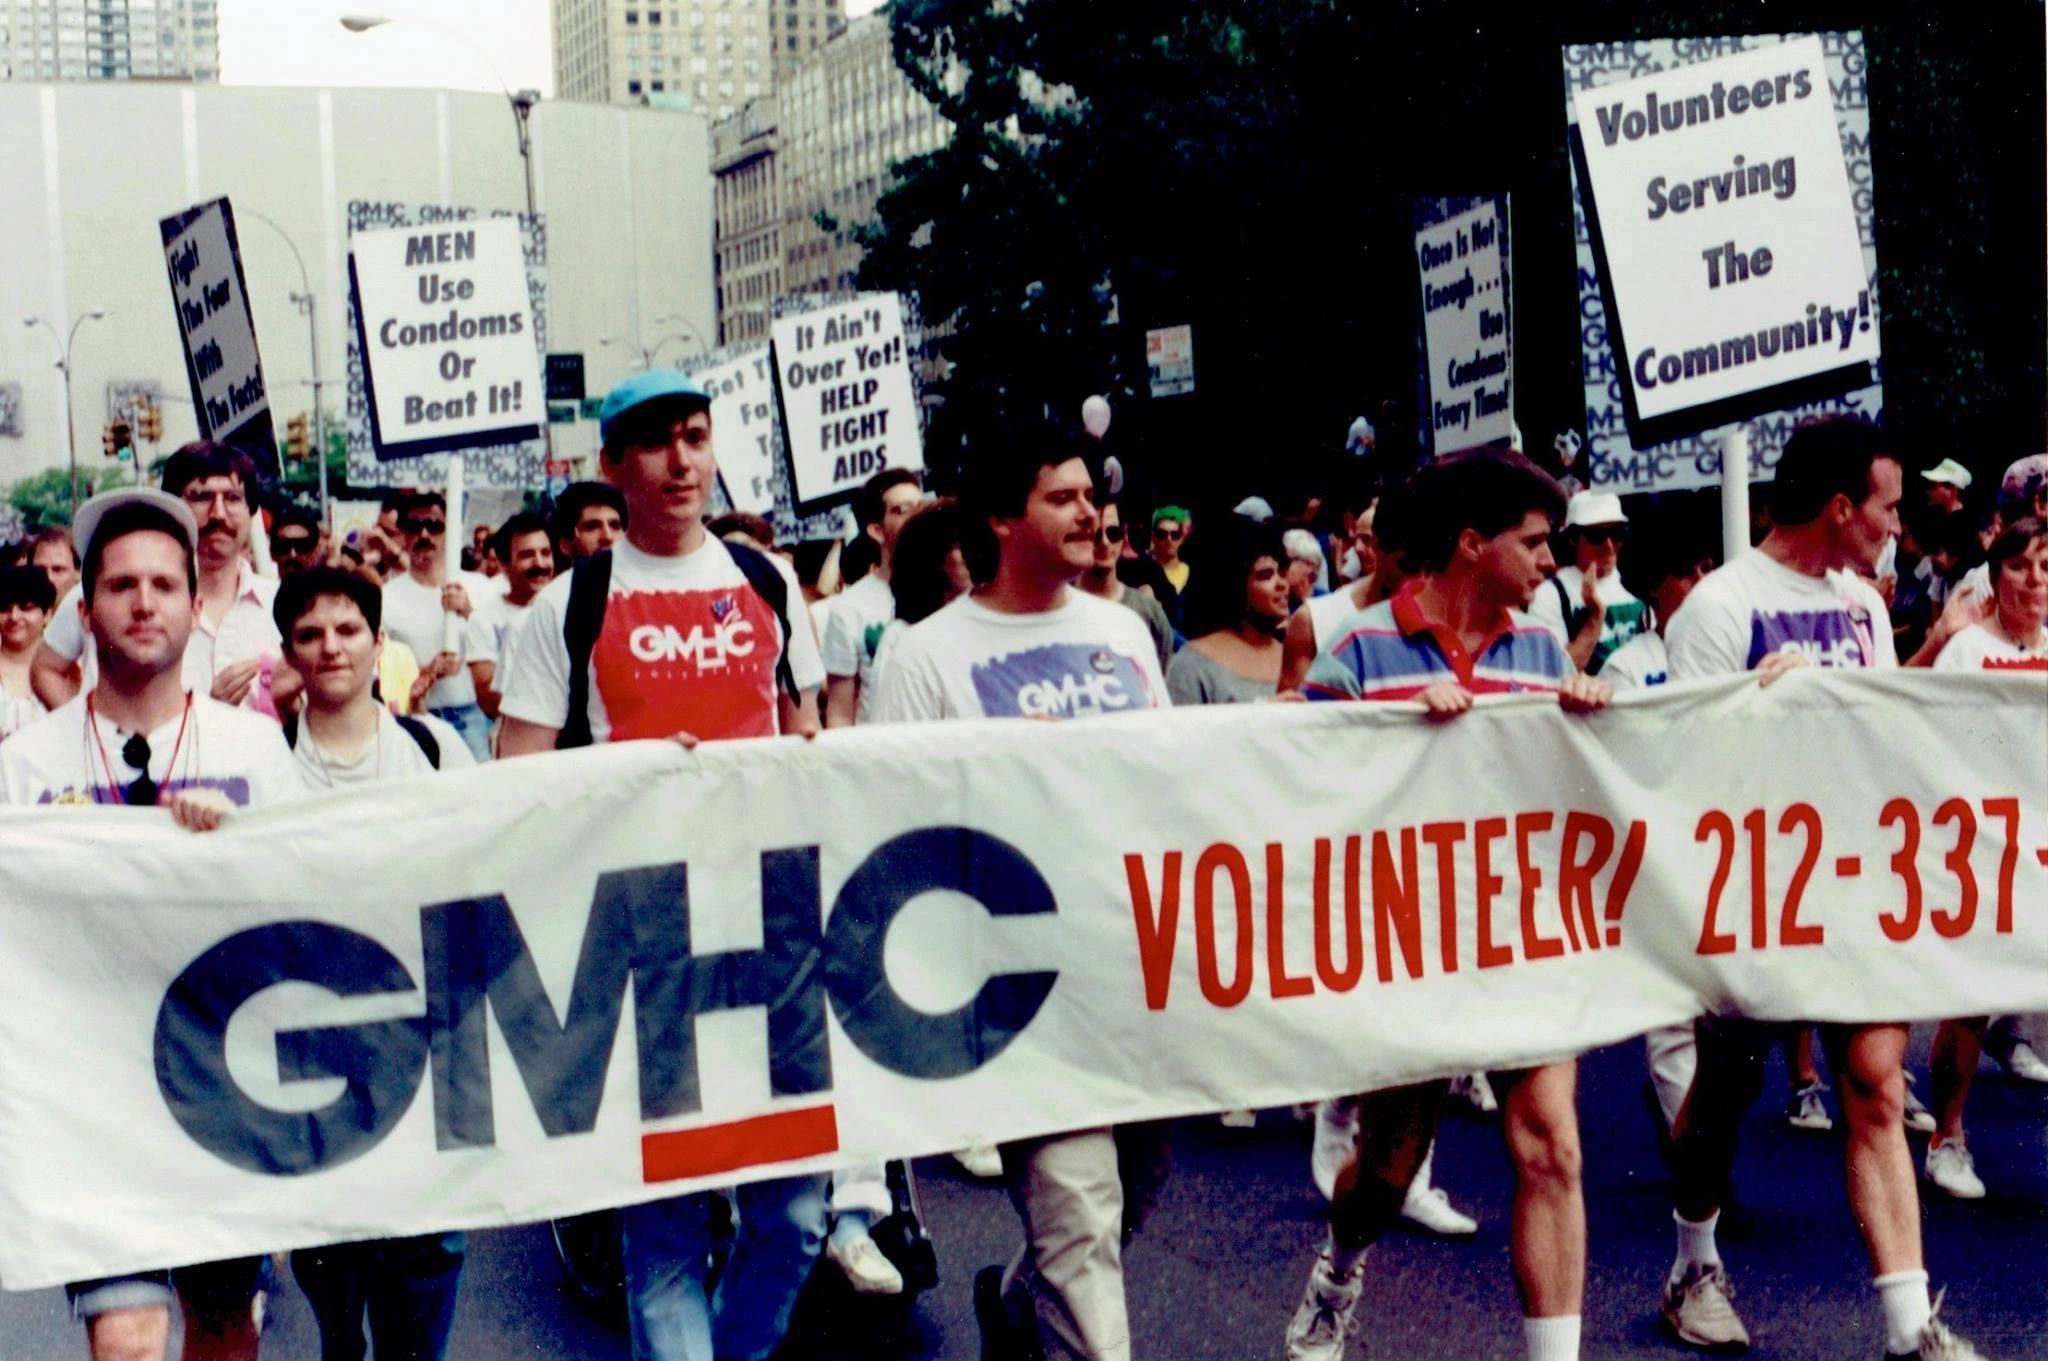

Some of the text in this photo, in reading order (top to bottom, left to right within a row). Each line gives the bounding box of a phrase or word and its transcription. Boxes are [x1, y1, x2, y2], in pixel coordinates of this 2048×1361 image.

[1595, 68, 1813, 148] Volunteers
[1646, 154, 1796, 221] Serving
[404, 230, 475, 267] MEN
[1421, 217, 1495, 272] Once Is Not
[1702, 240, 1773, 289] The
[418, 273, 475, 304] Use
[380, 311, 523, 348] Condoms
[796, 325, 814, 352] It
[823, 310, 882, 346] Ain't
[1634, 290, 1871, 390] Community!
[439, 351, 476, 381] Or
[703, 370, 745, 400] Get
[787, 336, 901, 390] Over Yet!
[404, 381, 522, 425] Beat It!
[820, 379, 879, 416] HELP
[1434, 400, 1471, 431] Every
[820, 409, 889, 451] FIGHT
[833, 445, 887, 484] AIDS
[629, 619, 756, 670] GMHC
[1017, 672, 1129, 717] GMHC
[1123, 810, 1648, 1011] VOLUNTEER!
[153, 825, 1060, 1178] GMHC
